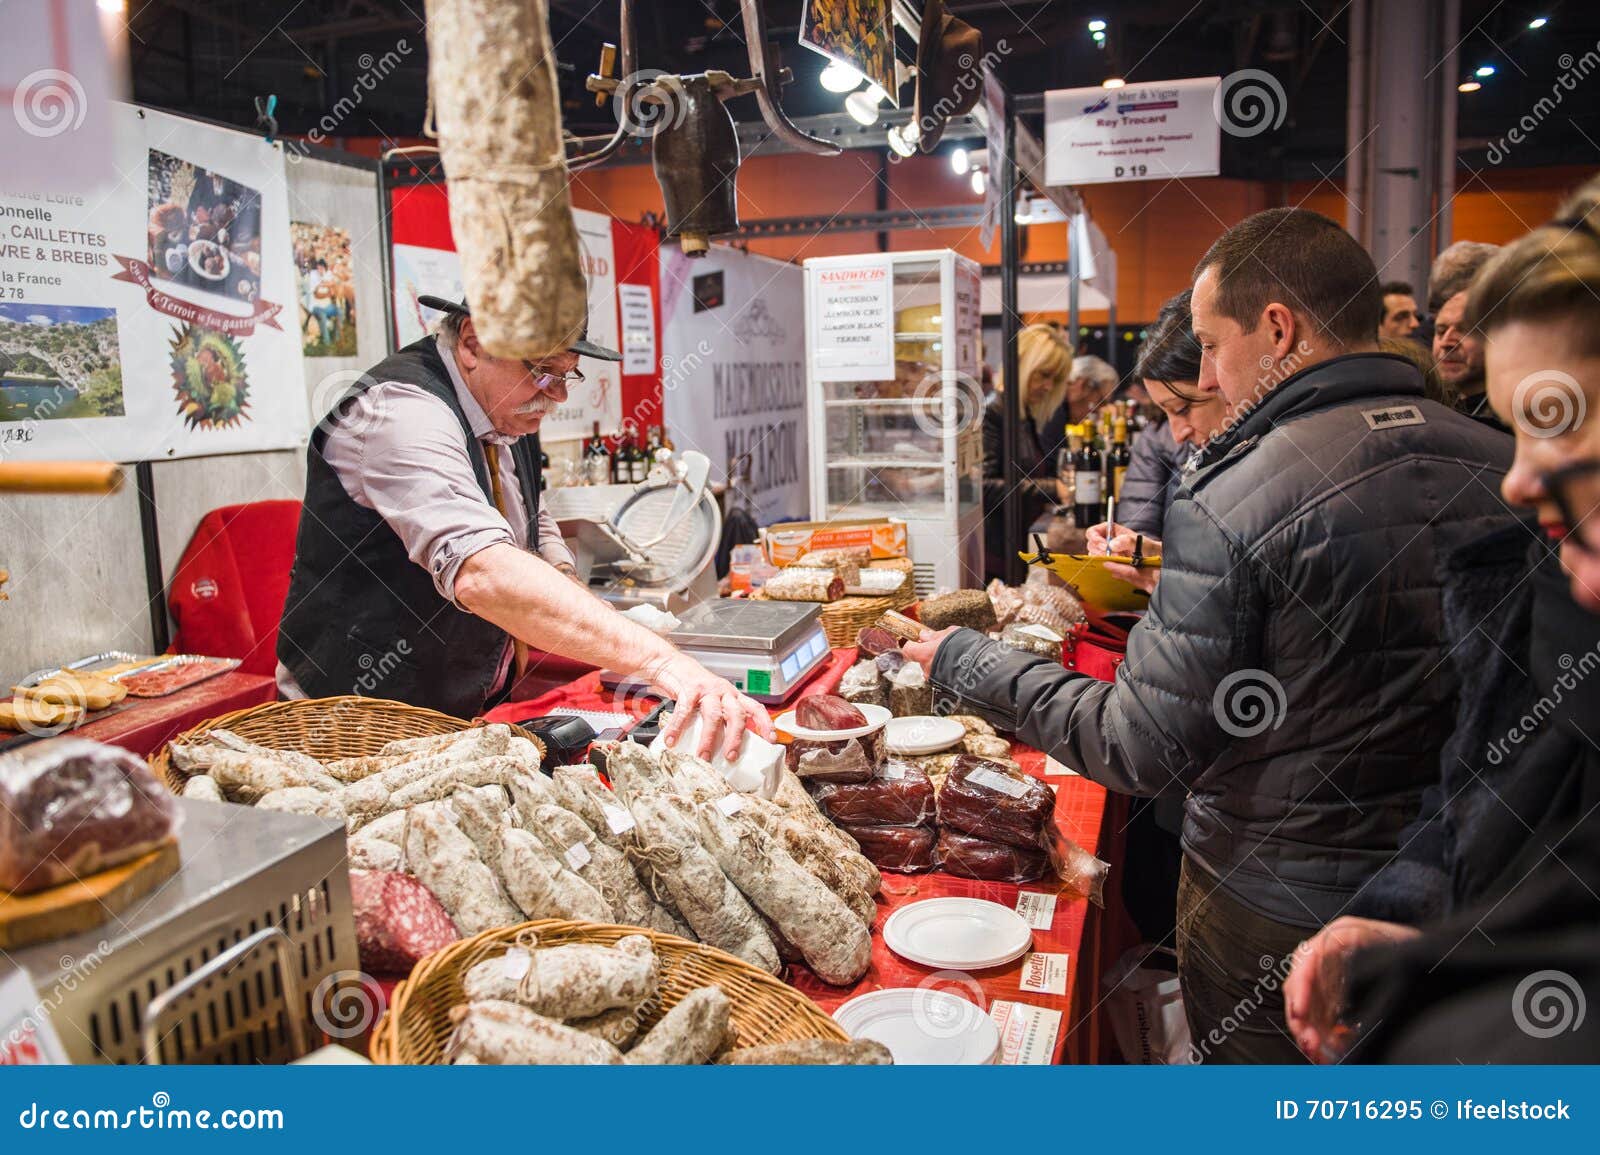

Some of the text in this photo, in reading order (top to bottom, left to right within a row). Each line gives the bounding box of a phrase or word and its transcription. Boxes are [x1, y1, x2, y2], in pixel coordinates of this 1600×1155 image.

[1150, 88, 1179, 102] Vigne
[1120, 114, 1168, 126] Trocard
[1114, 165, 1147, 177] D 19
[10, 224, 107, 248] CAILLETTES
[35, 247, 46, 261] &
[51, 248, 108, 266] BREBIS
[2, 271, 61, 285] la France
[9, 287, 24, 299] 78
[1025, 953, 1045, 988] Rosette
